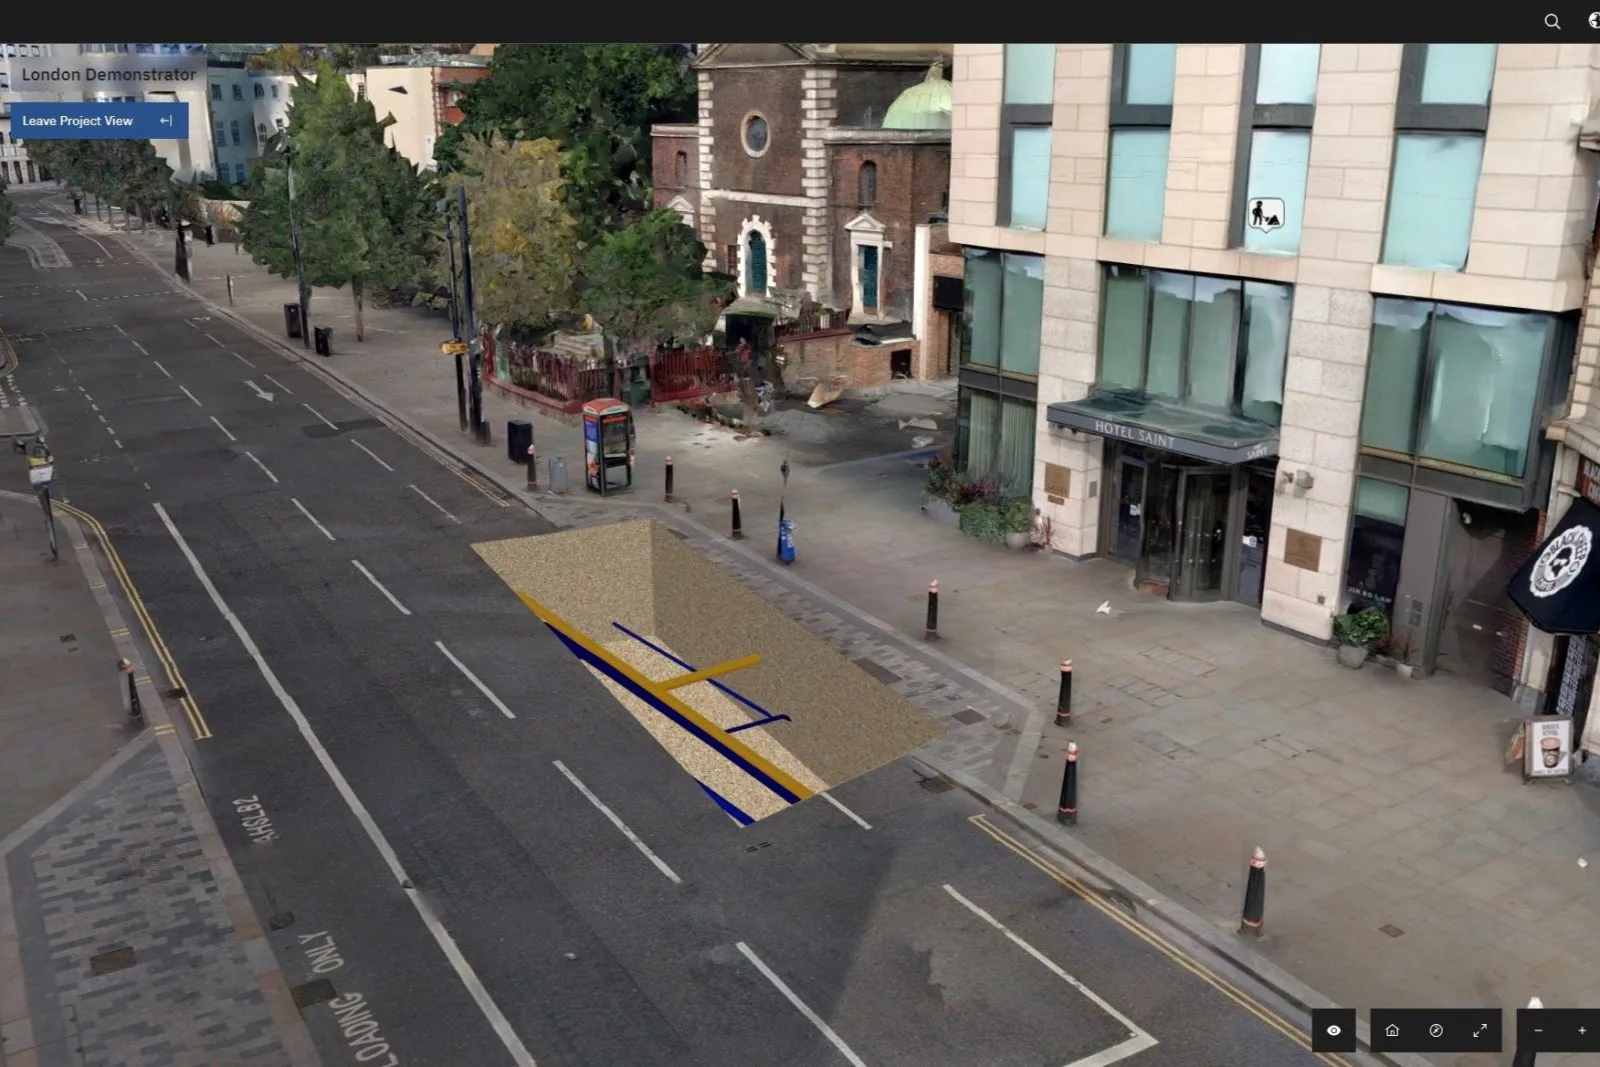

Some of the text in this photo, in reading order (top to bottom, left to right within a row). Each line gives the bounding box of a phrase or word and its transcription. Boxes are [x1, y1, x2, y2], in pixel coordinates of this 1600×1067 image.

[1095, 420, 1175, 449] HOTEL SAINT
[298, 930, 399, 1067] LOADING ONLY
